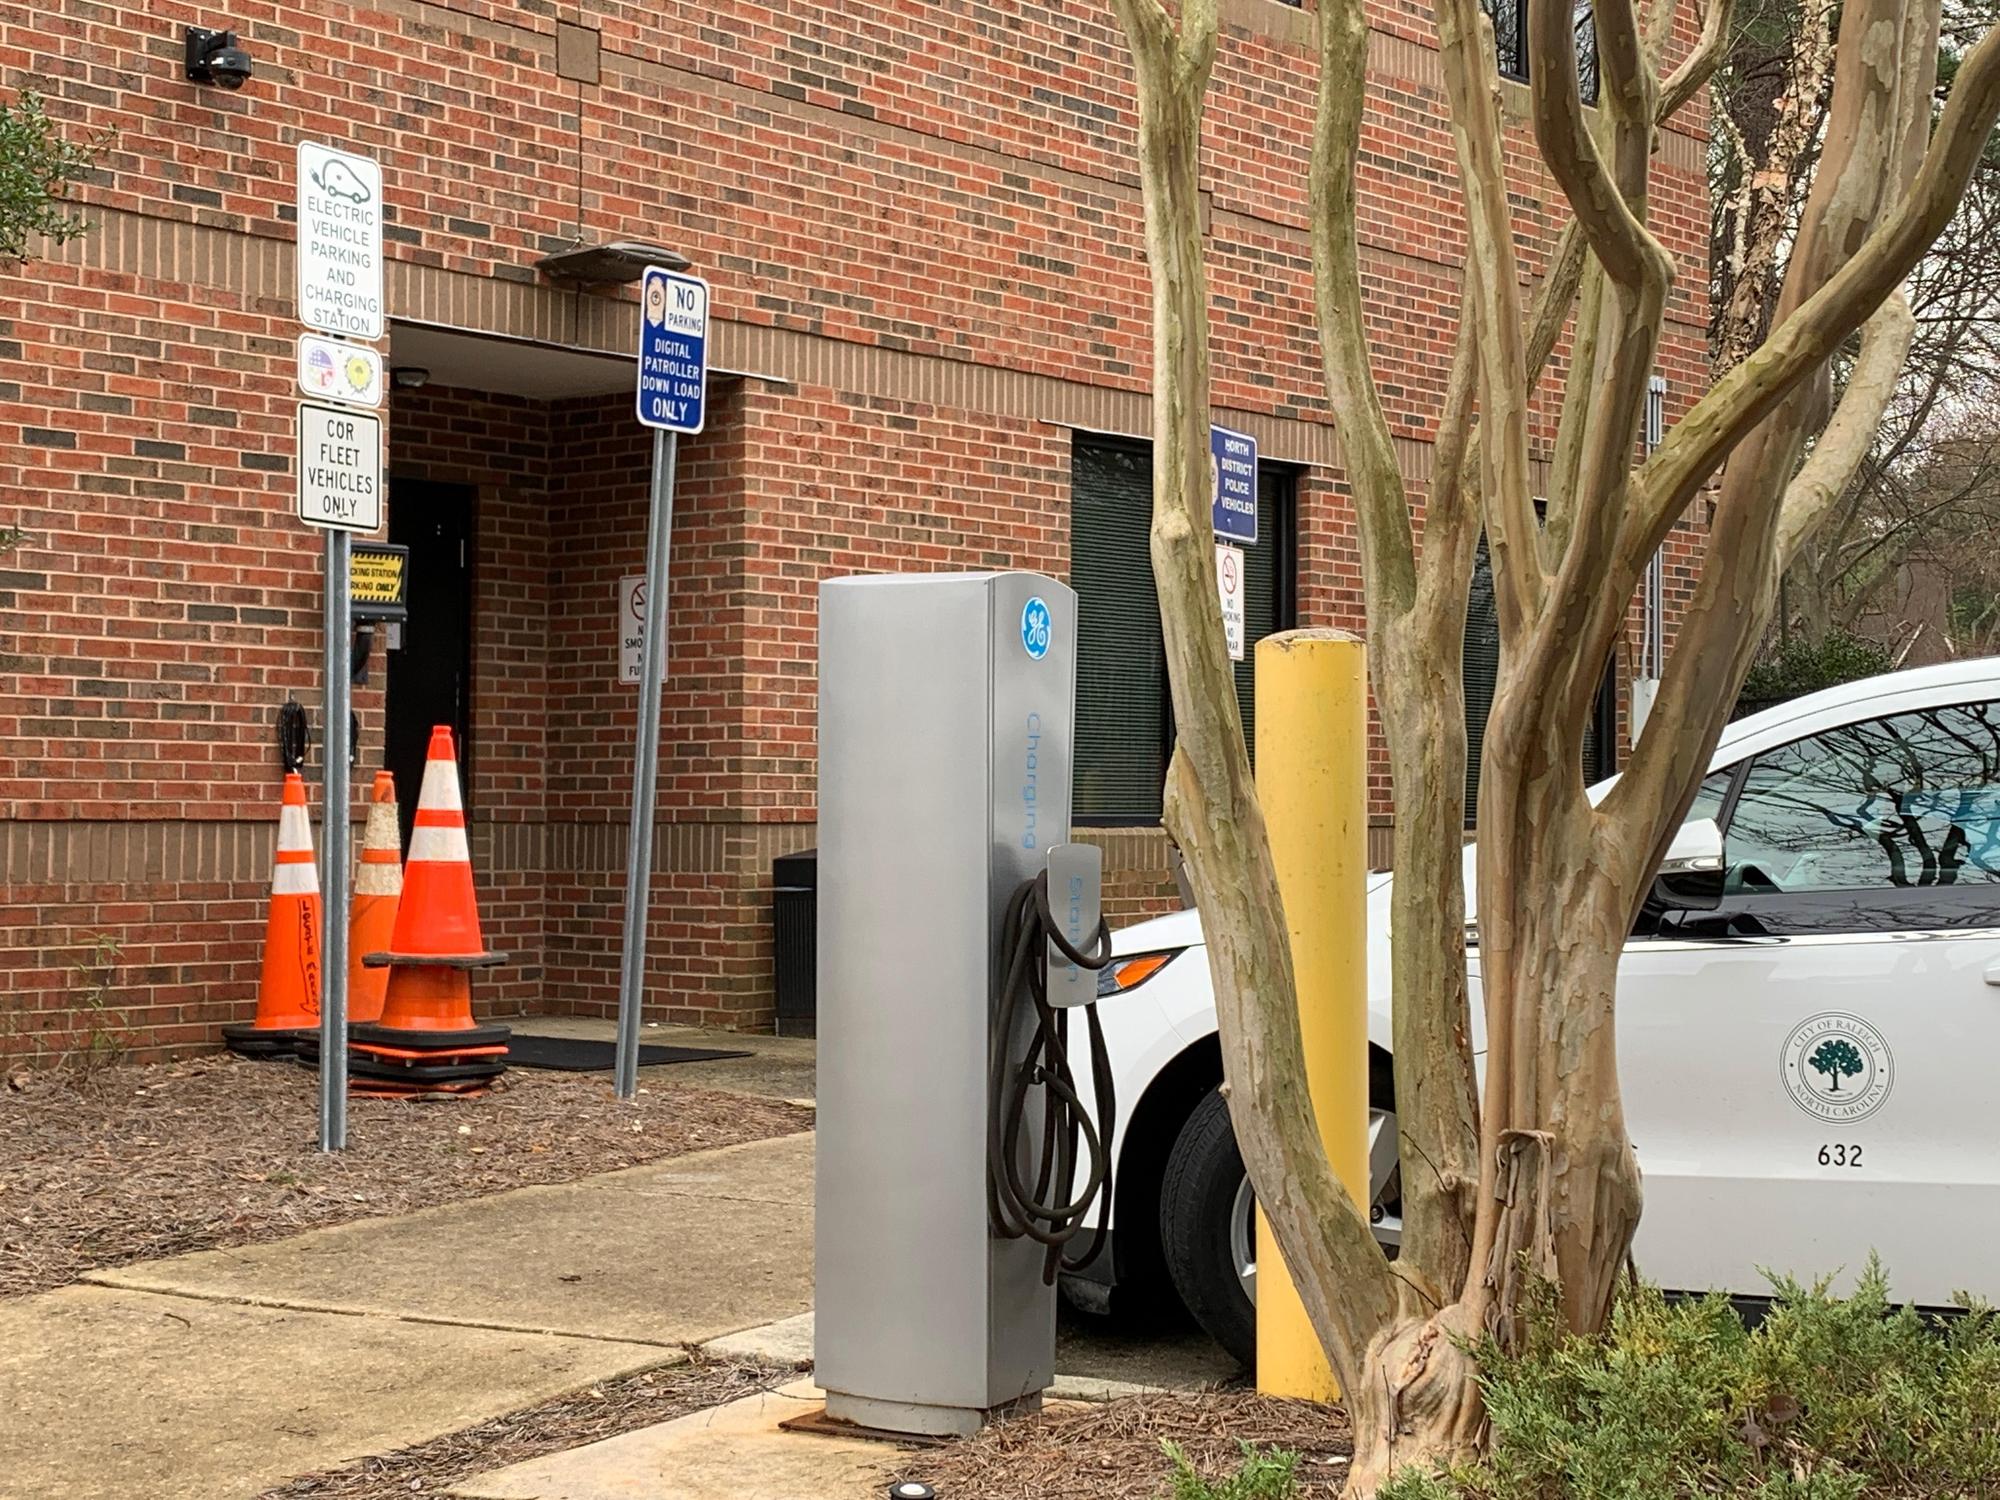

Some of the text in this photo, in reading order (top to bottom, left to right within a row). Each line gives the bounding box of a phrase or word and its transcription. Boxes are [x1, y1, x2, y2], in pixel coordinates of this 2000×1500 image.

[307, 196, 374, 226] ELECTRIC
[311, 218, 370, 247] VEHICLE
[311, 240, 371, 269] PARKING
[326, 267, 356, 287] AND
[305, 283, 378, 313] CHARGING
[674, 285, 695, 311] NO
[313, 307, 370, 332] STATION
[668, 312, 702, 332] PARKING
[655, 338, 692, 360] DIGITAL
[644, 356, 700, 380] PATROLLER
[642, 375, 700, 400] DOWN LOAD
[652, 397, 688, 422] ONLY
[326, 419, 354, 441] COR
[320, 443, 360, 468] FLEET
[1224, 438, 1249, 456] NORTH
[1221, 457, 1253, 477] DISTRICT
[307, 466, 373, 495] VEHICLES
[1224, 477, 1250, 496] POLICE
[322, 495, 357, 518] ONLY
[1220, 495, 1254, 515] VEHICLES
[371, 568, 397, 578] STATION
[376, 582, 395, 592] ONLY
[1022, 712, 1042, 849] Charging
[1068, 874, 1083, 982] Statin
[1793, 1019, 1882, 1053] CITY OF RALEIGH
[1793, 1083, 1884, 1117] NORTH CAROLINA
[1817, 1143, 1863, 1168] 632
